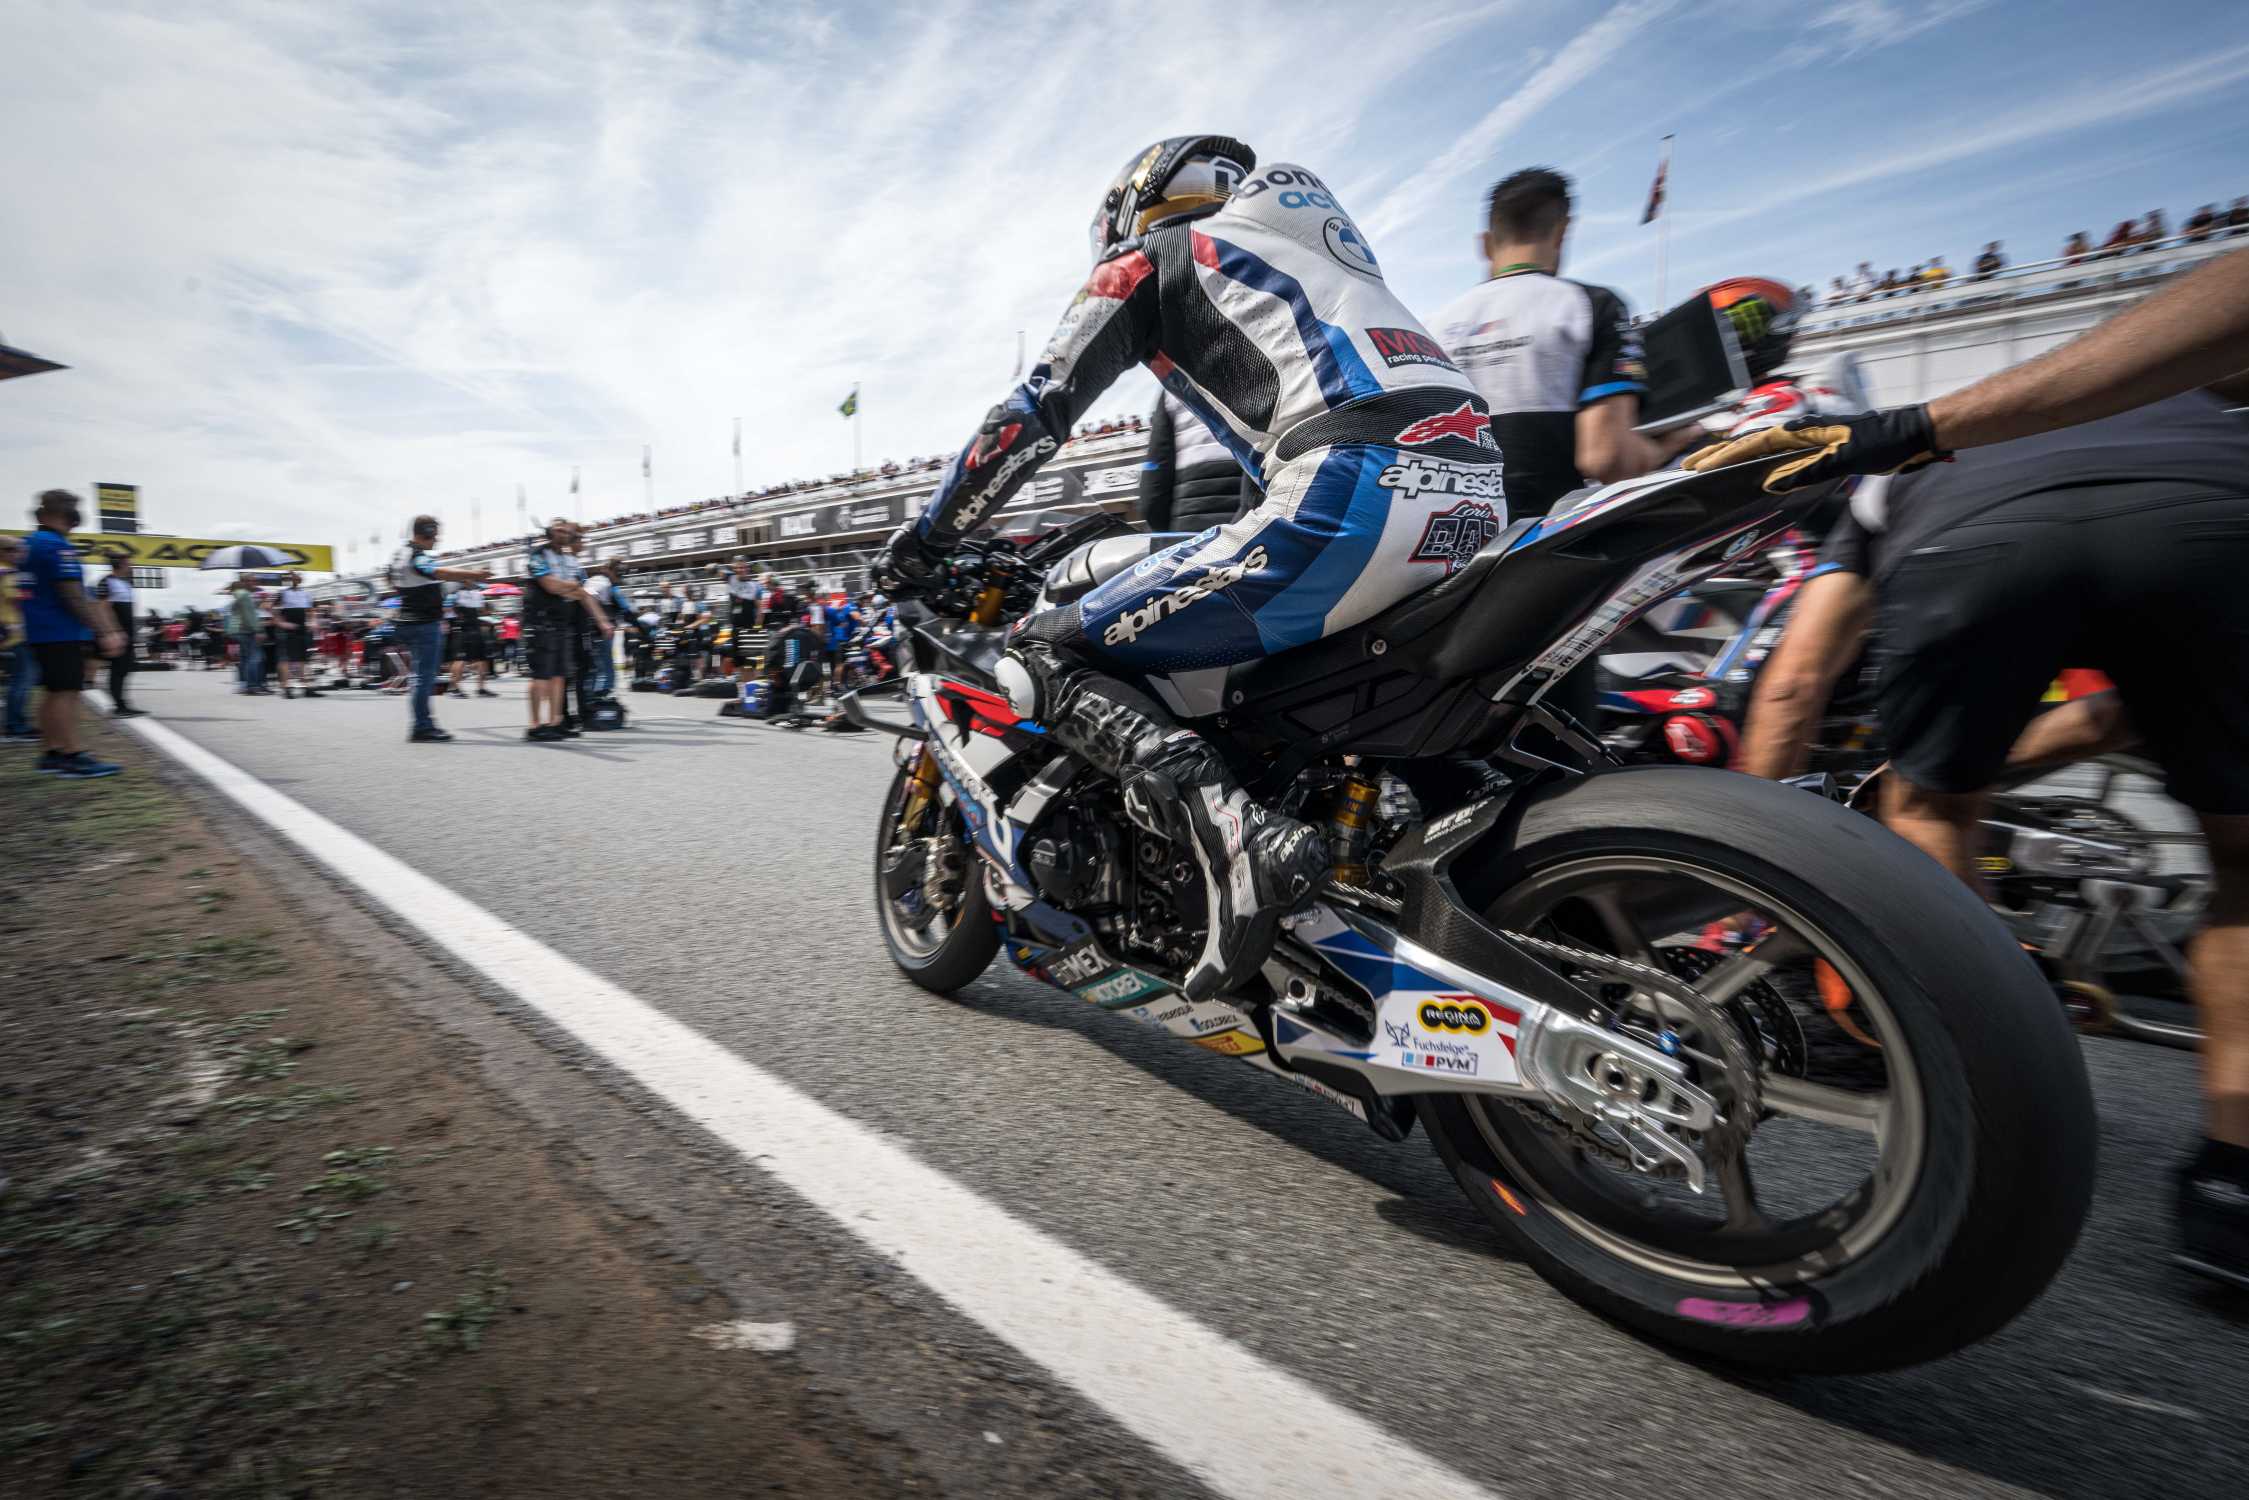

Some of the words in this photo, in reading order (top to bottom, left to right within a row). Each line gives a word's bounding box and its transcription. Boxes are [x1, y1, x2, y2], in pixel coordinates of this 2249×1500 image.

[1387, 352, 1422, 363] racing
[952, 435, 1057, 531] alpinestars
[1425, 1008, 1482, 1026] REGINA
[1436, 1056, 1470, 1071] PVM
